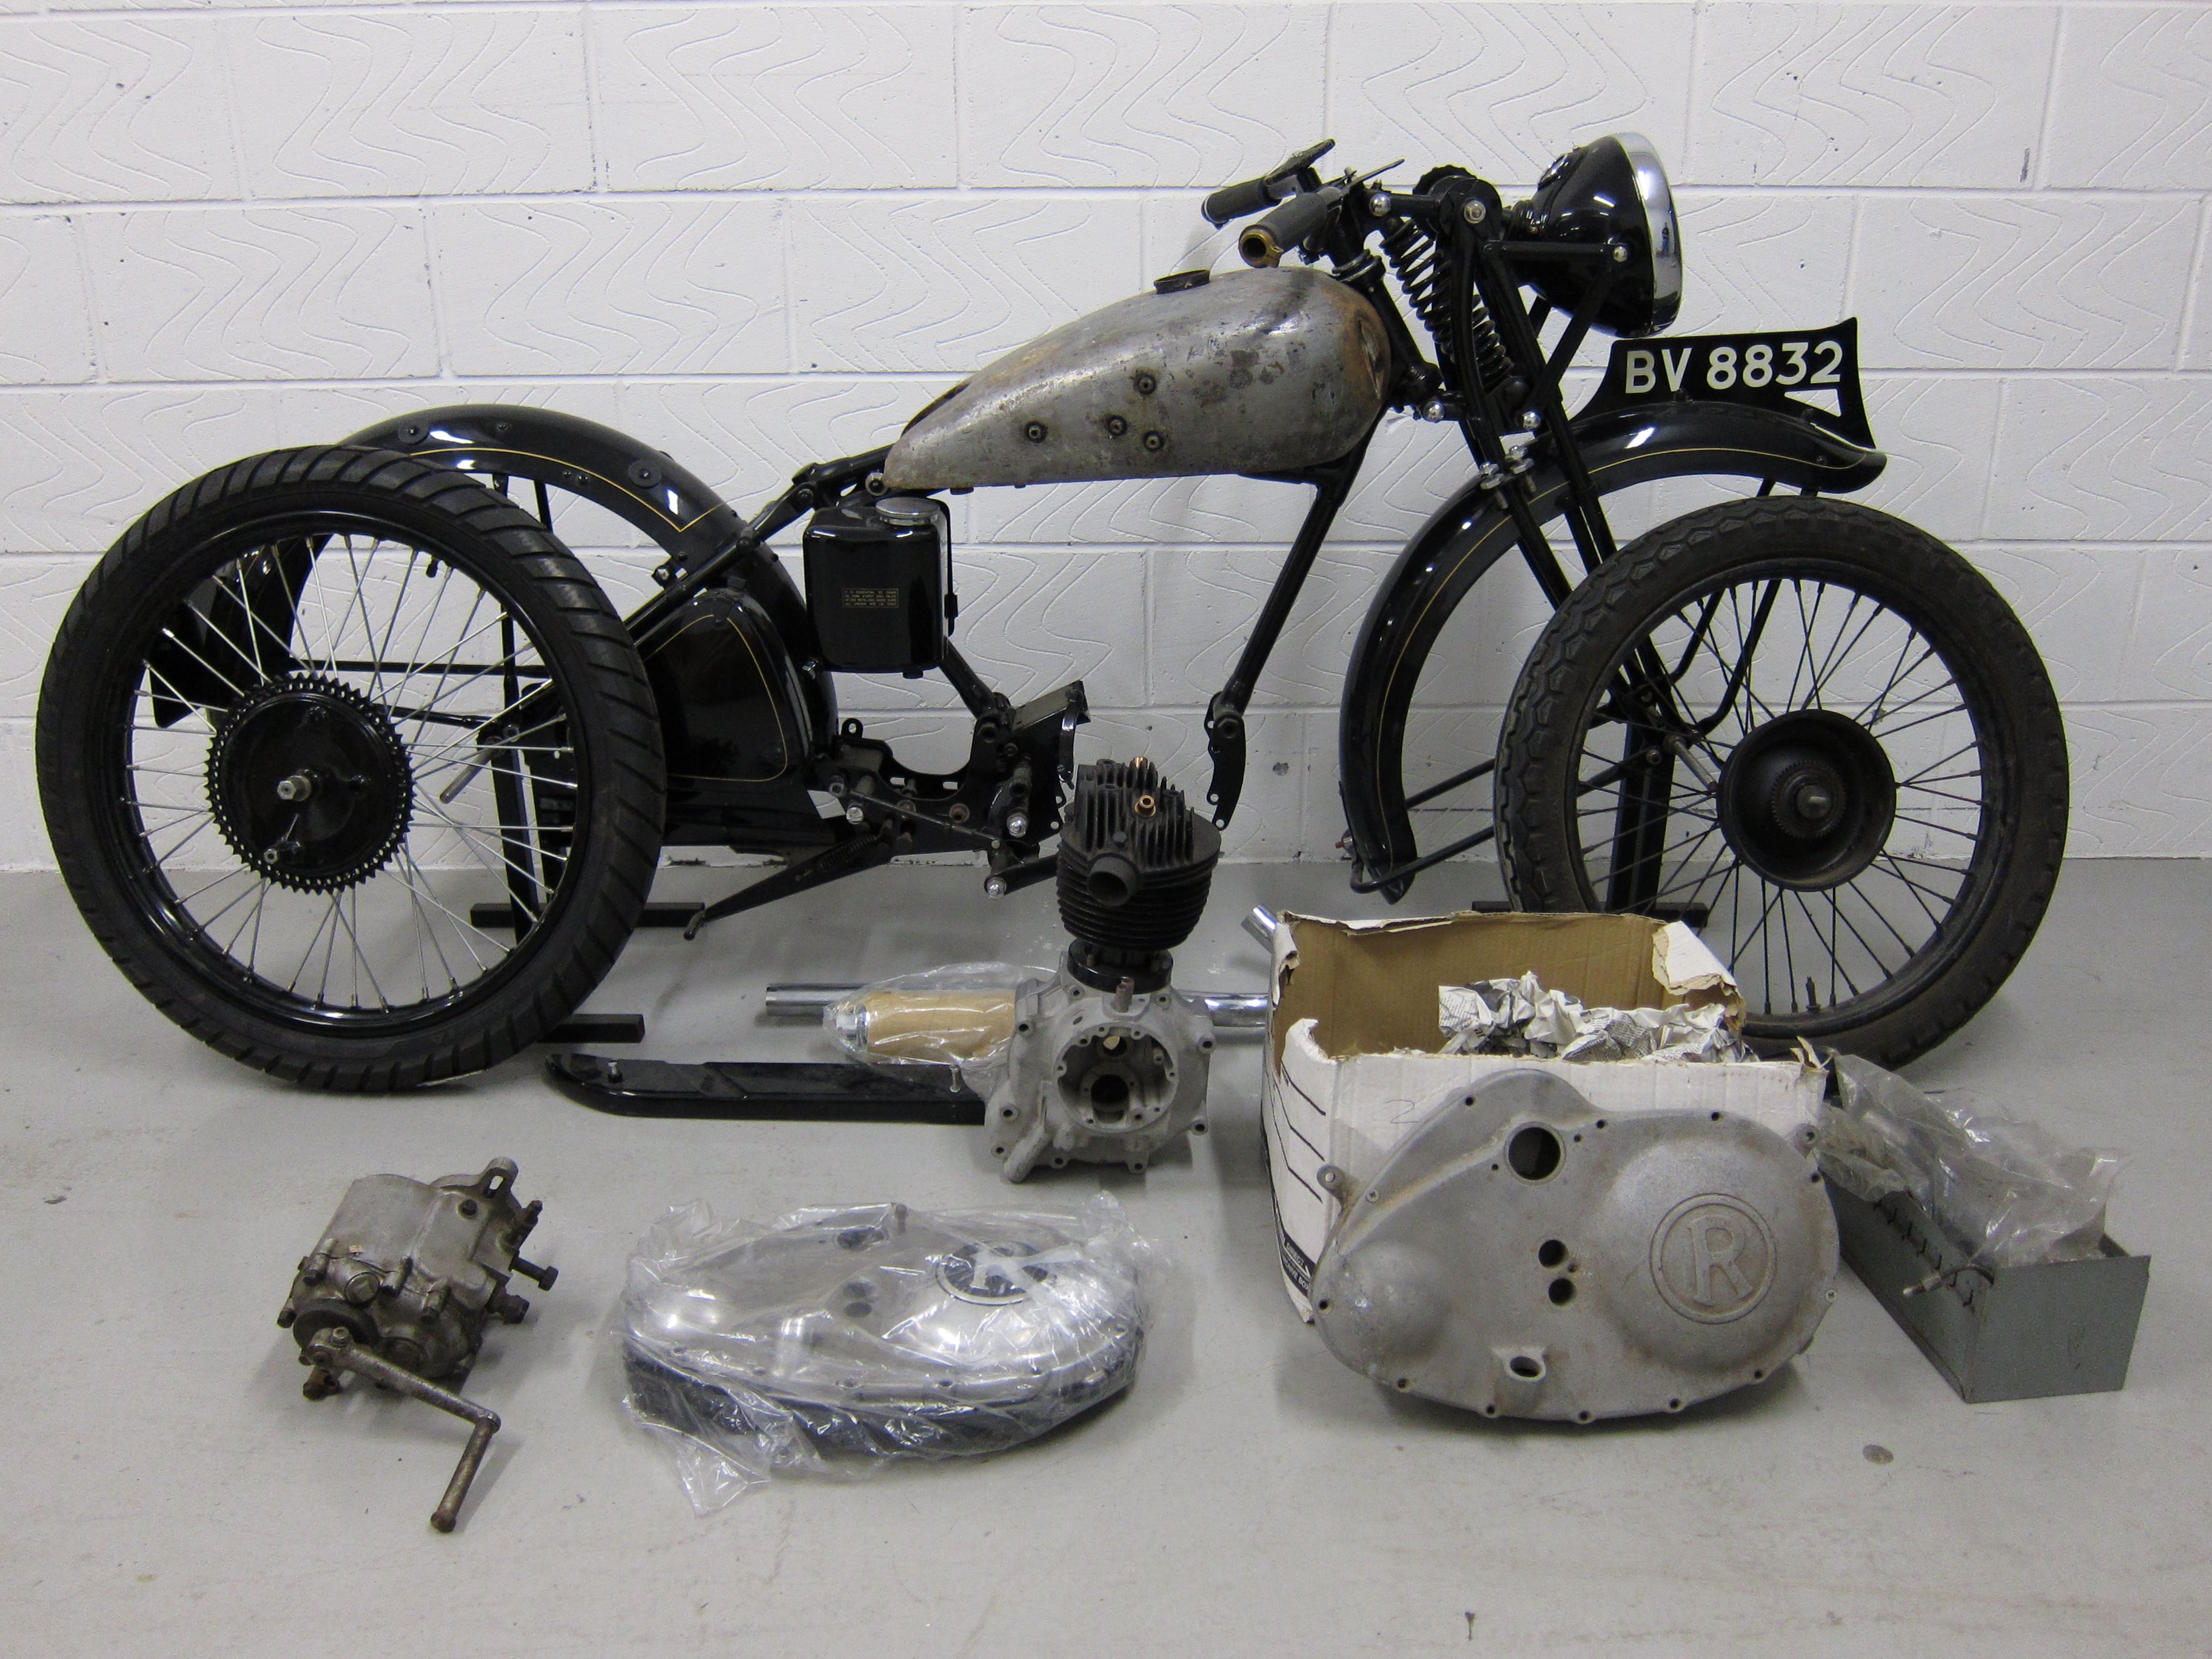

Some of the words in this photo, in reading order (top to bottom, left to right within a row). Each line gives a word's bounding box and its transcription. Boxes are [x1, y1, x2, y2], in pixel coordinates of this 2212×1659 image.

[1625, 347, 1692, 394] BV
[1706, 340, 1843, 390] 8832
[1686, 1214, 1754, 1307] R
